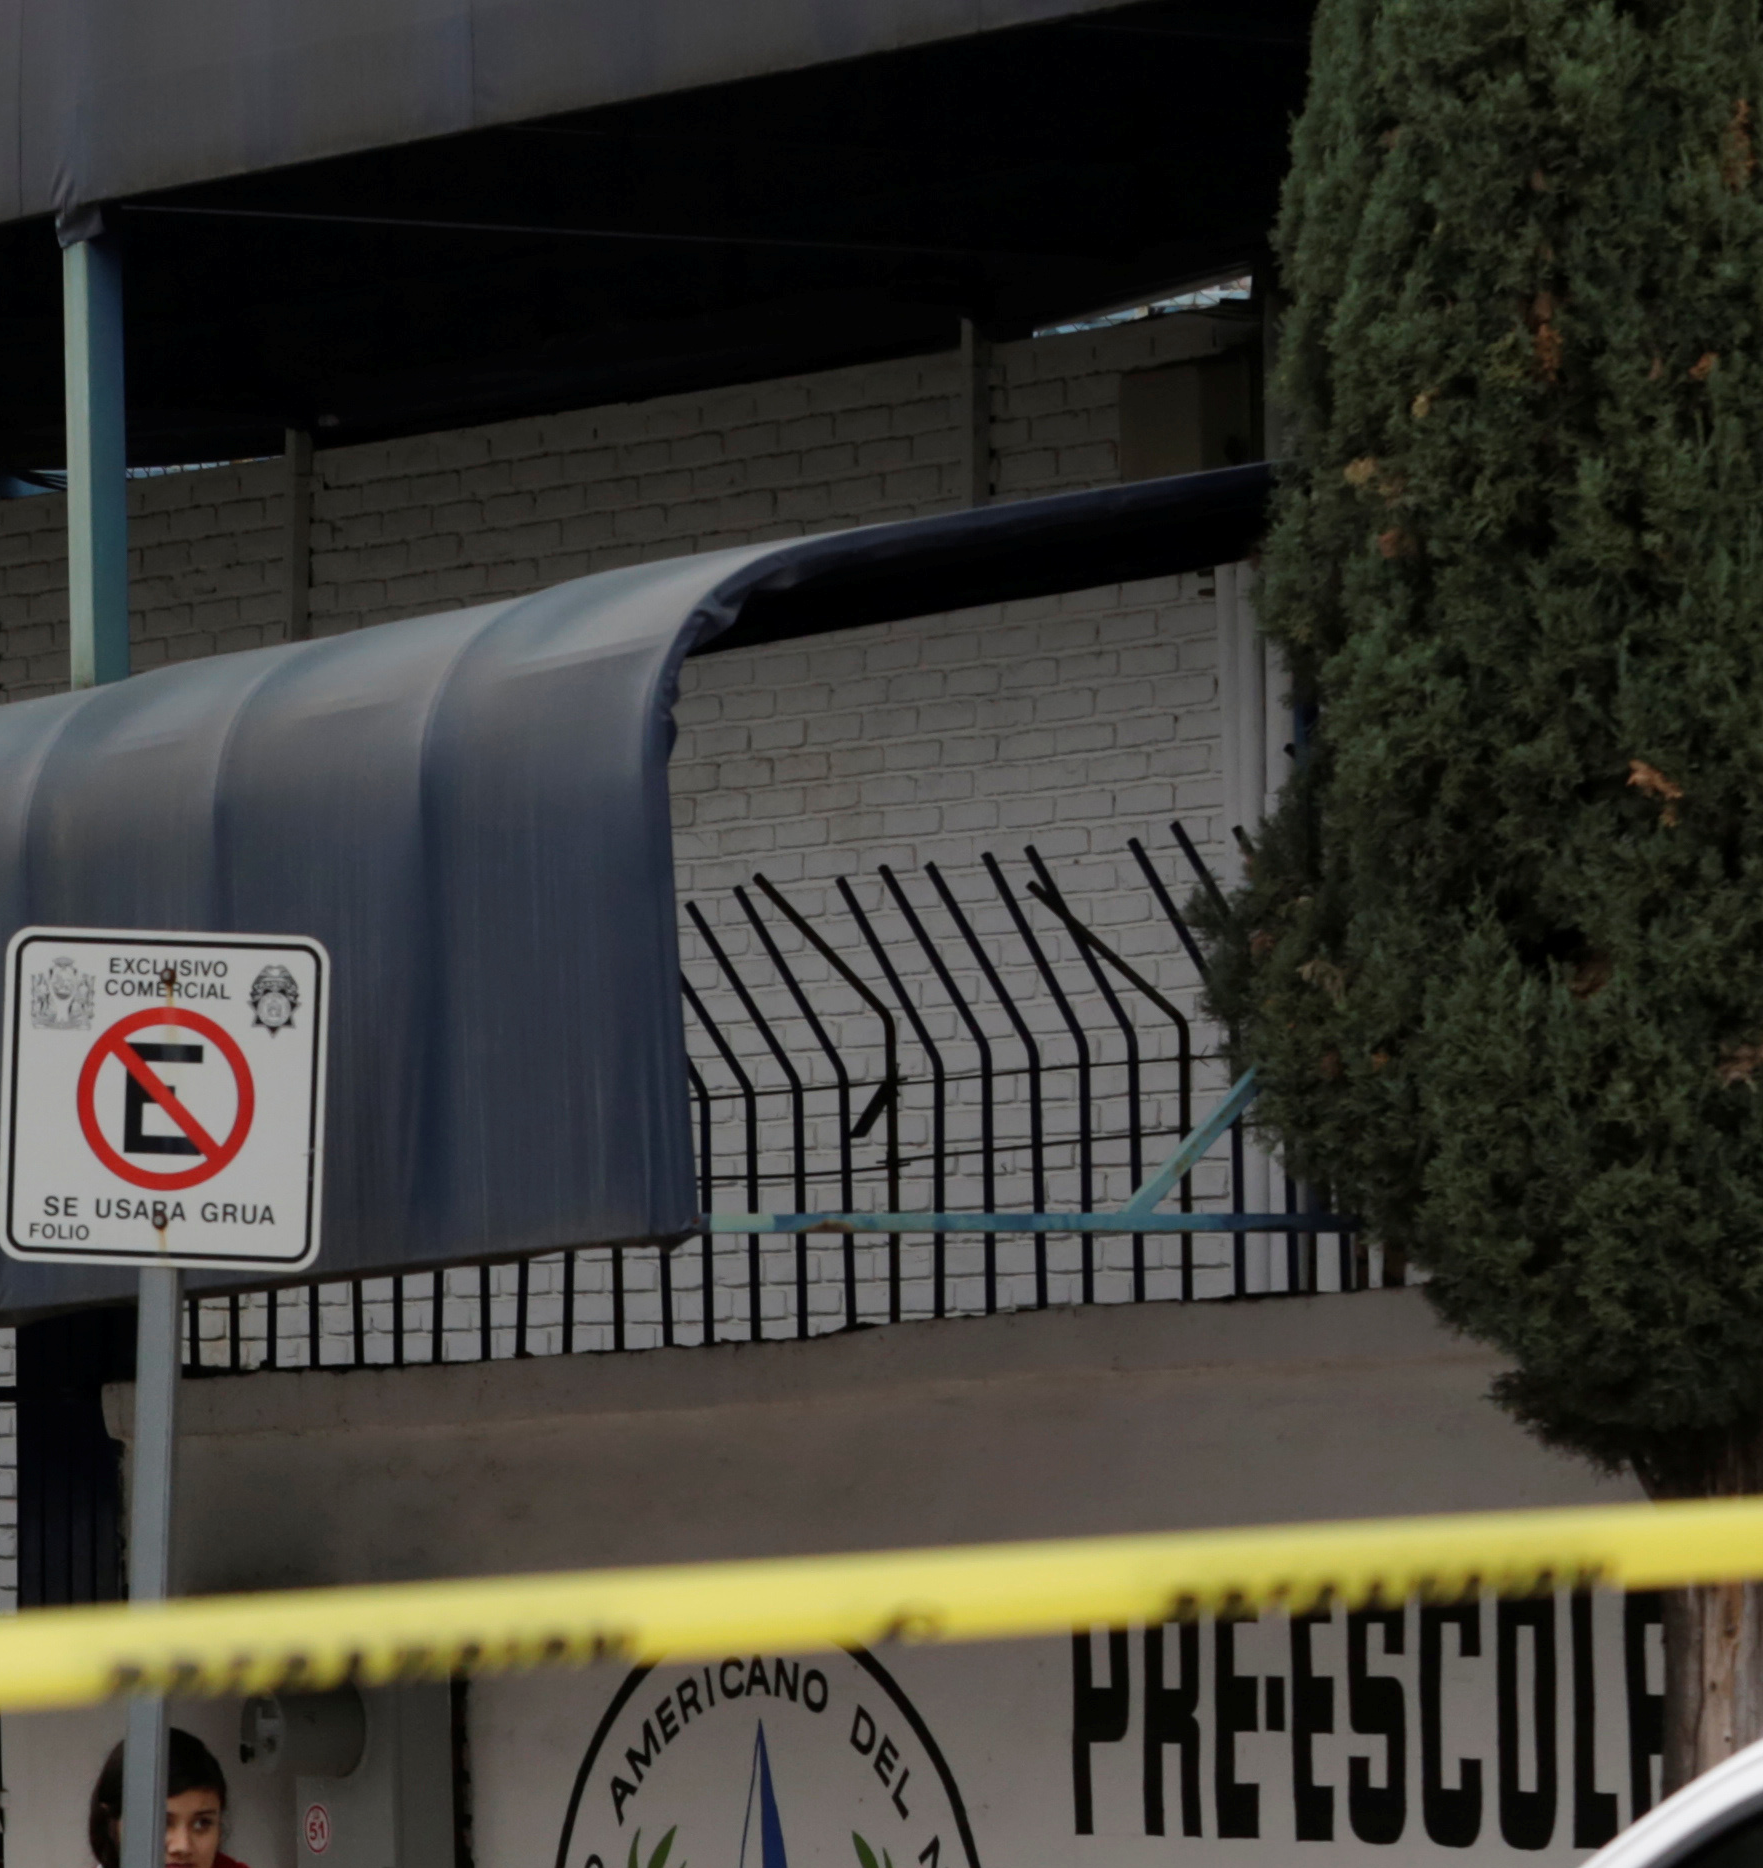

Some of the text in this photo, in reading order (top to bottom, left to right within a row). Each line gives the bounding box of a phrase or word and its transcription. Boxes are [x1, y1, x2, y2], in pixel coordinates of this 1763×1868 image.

[109, 957, 229, 979] EXCLUSIVO
[104, 979, 231, 1001] COMERCIAL
[43, 1195, 276, 1226] SE USARA GRUA
[28, 1223, 91, 1242] FOLIO
[609, 1654, 830, 1827] AMERICANO
[849, 1704, 911, 1821] DEL
